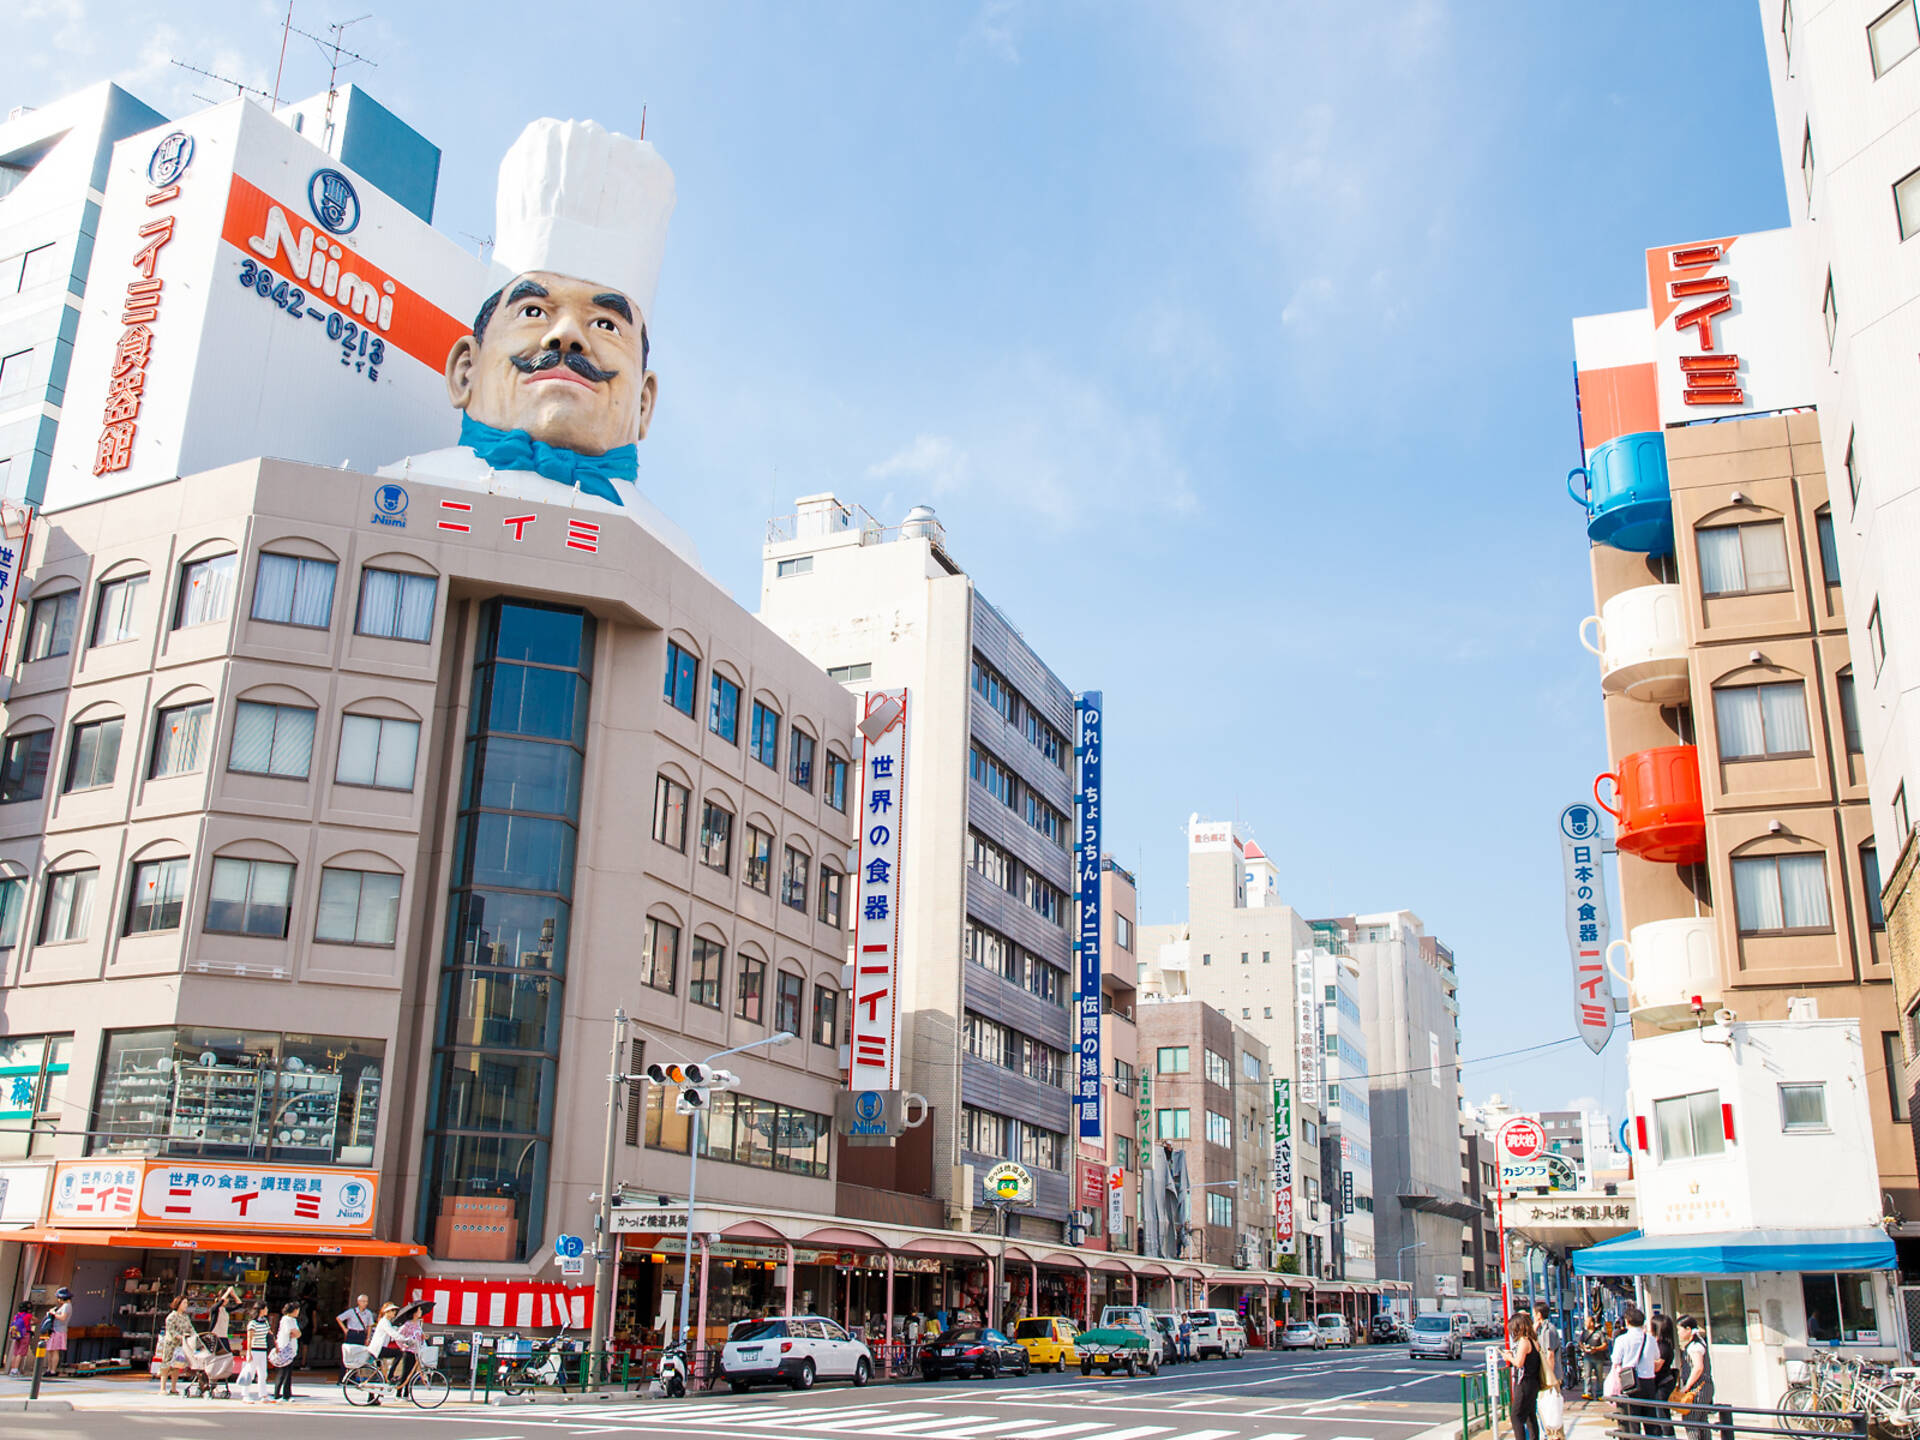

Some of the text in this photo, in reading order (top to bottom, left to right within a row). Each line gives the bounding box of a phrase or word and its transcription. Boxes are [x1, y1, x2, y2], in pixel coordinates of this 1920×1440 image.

[248, 205, 396, 331] Niimi
[93, 184, 181, 477] ニイミ食器館
[239, 258, 385, 365] 3842-0213
[1671, 246, 1744, 405] ニイミ
[370, 513, 408, 528] Niimi
[436, 499, 601, 554] ニイミ
[864, 755, 894, 920] 世界の食器
[1574, 846, 1598, 942] 日本の食器
[856, 944, 889, 1068] ニイミ
[1579, 950, 1607, 1027] ニイミ
[850, 1120, 887, 1135] Niimi
[1275, 1079, 1290, 1136] ショーケース
[1140, 1108, 1151, 1164] サイトウ
[1506, 1133, 1536, 1148] 消火栓
[82, 1170, 136, 1185] 世界の食器
[169, 1172, 323, 1193] 世界の食器・調理器具
[1503, 1166, 1547, 1177] カジワラ
[77, 1186, 134, 1212] ニイミ
[165, 1188, 321, 1219] ニイミ
[336, 1208, 365, 1219] Niimi
[1530, 1205, 1630, 1221] かっぱ橋道具街
[568, 1242, 576, 1253] P
